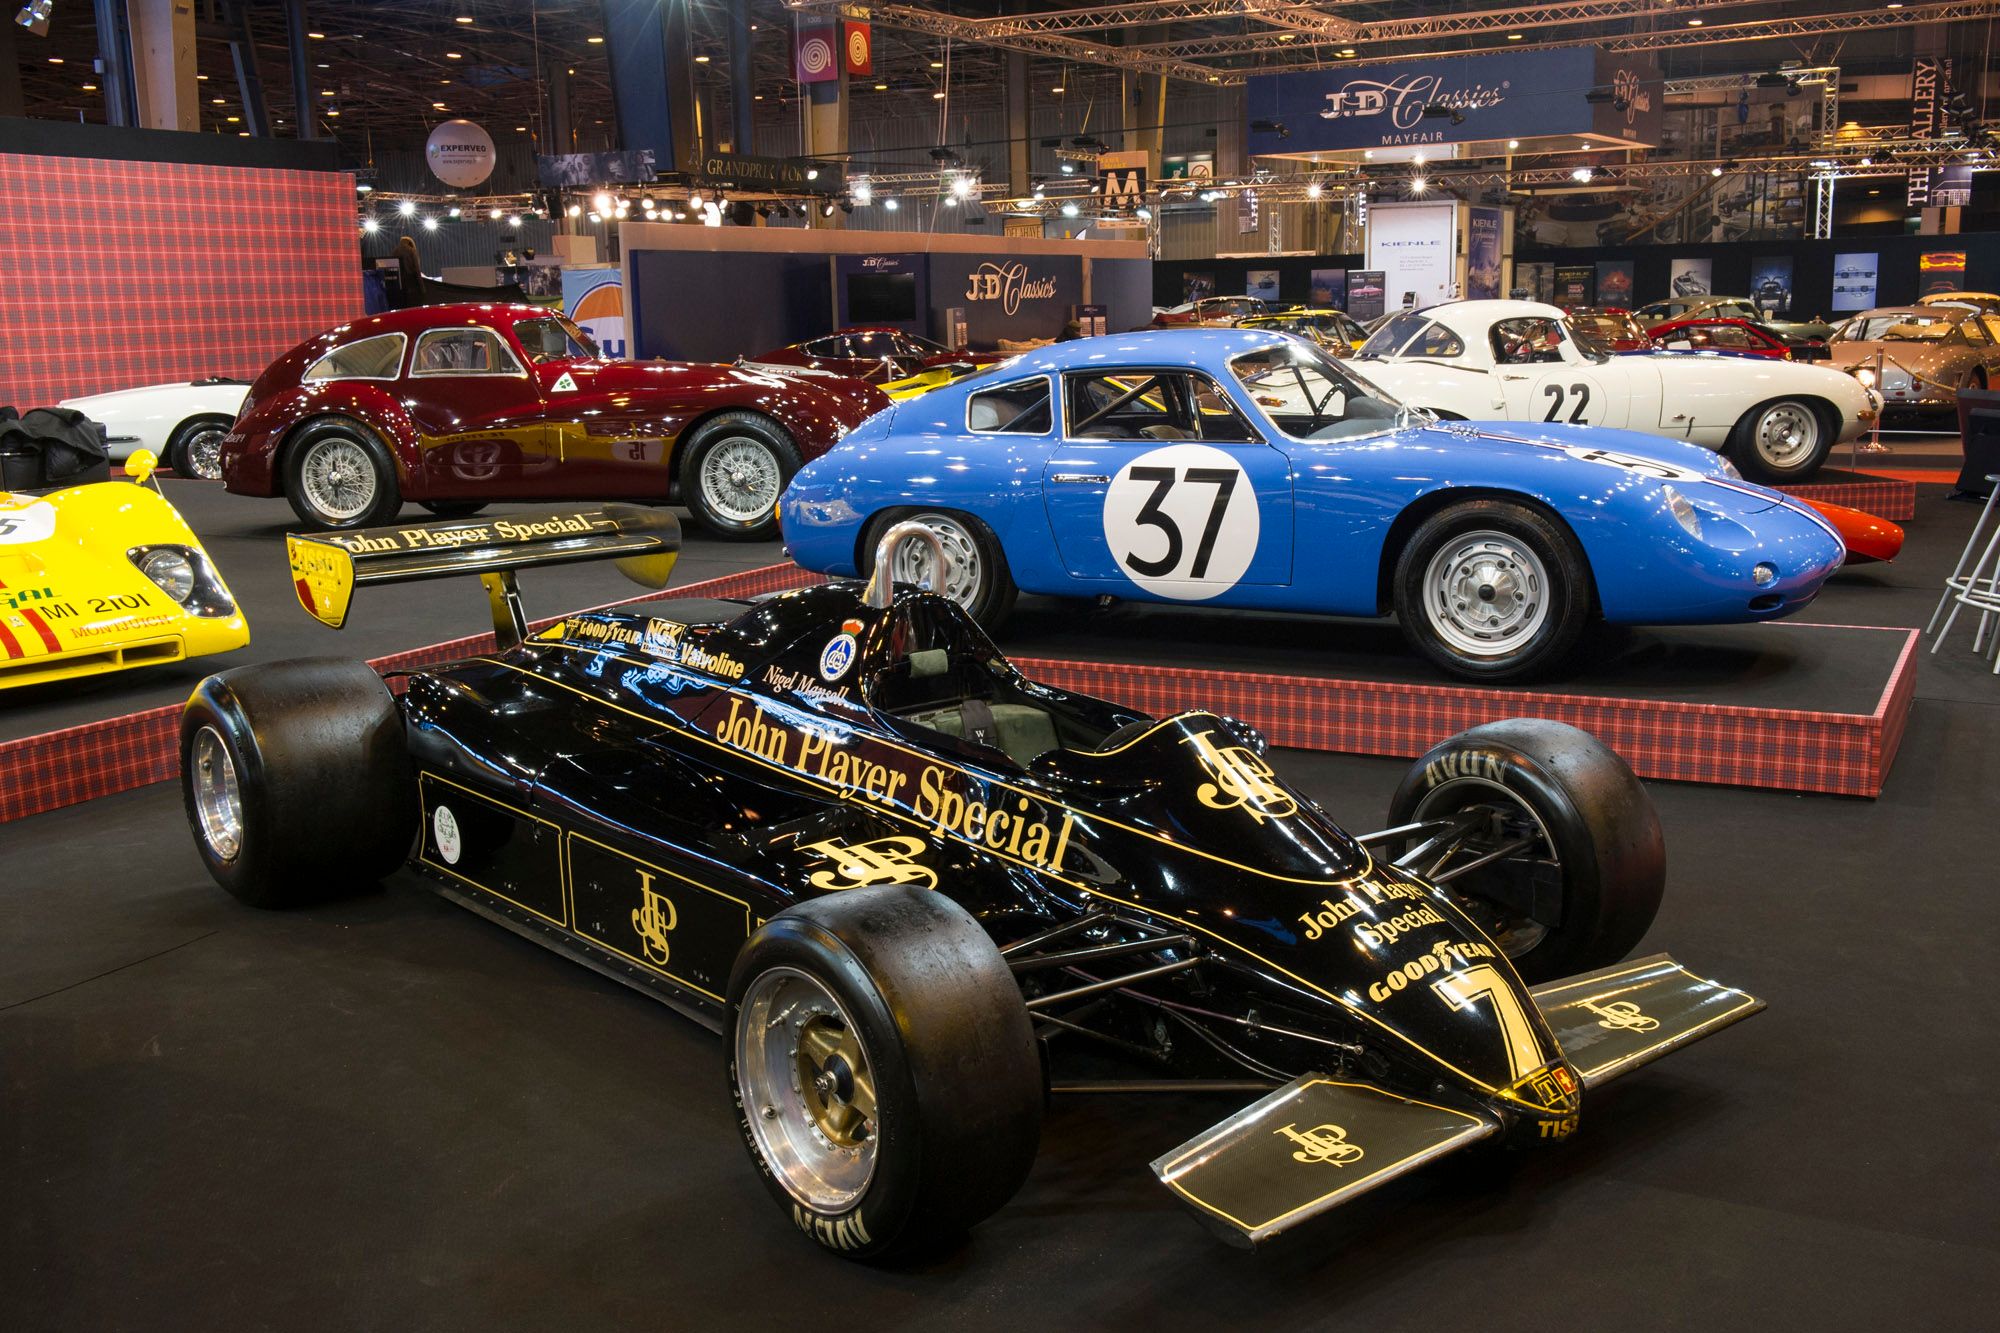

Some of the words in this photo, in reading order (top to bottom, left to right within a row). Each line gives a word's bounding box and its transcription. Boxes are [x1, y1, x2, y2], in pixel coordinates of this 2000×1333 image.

[1382, 131, 1443, 145] MAYFAIR
[1472, 218, 1497, 228] KIENLE
[1544, 383, 1591, 426] 22
[399, 525, 493, 548] Player
[494, 513, 593, 541] Special
[1127, 466, 1240, 579] 37
[40, 602, 79, 620] MI
[648, 620, 684, 648] NGK
[680, 641, 745, 680] Valvoline
[762, 664, 799, 693] Nigel
[796, 675, 850, 702] Mansell
[716, 697, 788, 766] John
[797, 727, 907, 808] Player
[912, 765, 1074, 873] Special
[1426, 749, 1509, 788] AVON
[1298, 892, 1370, 940] John
[1354, 903, 1446, 949] Special
[1430, 963, 1545, 1082] 7
